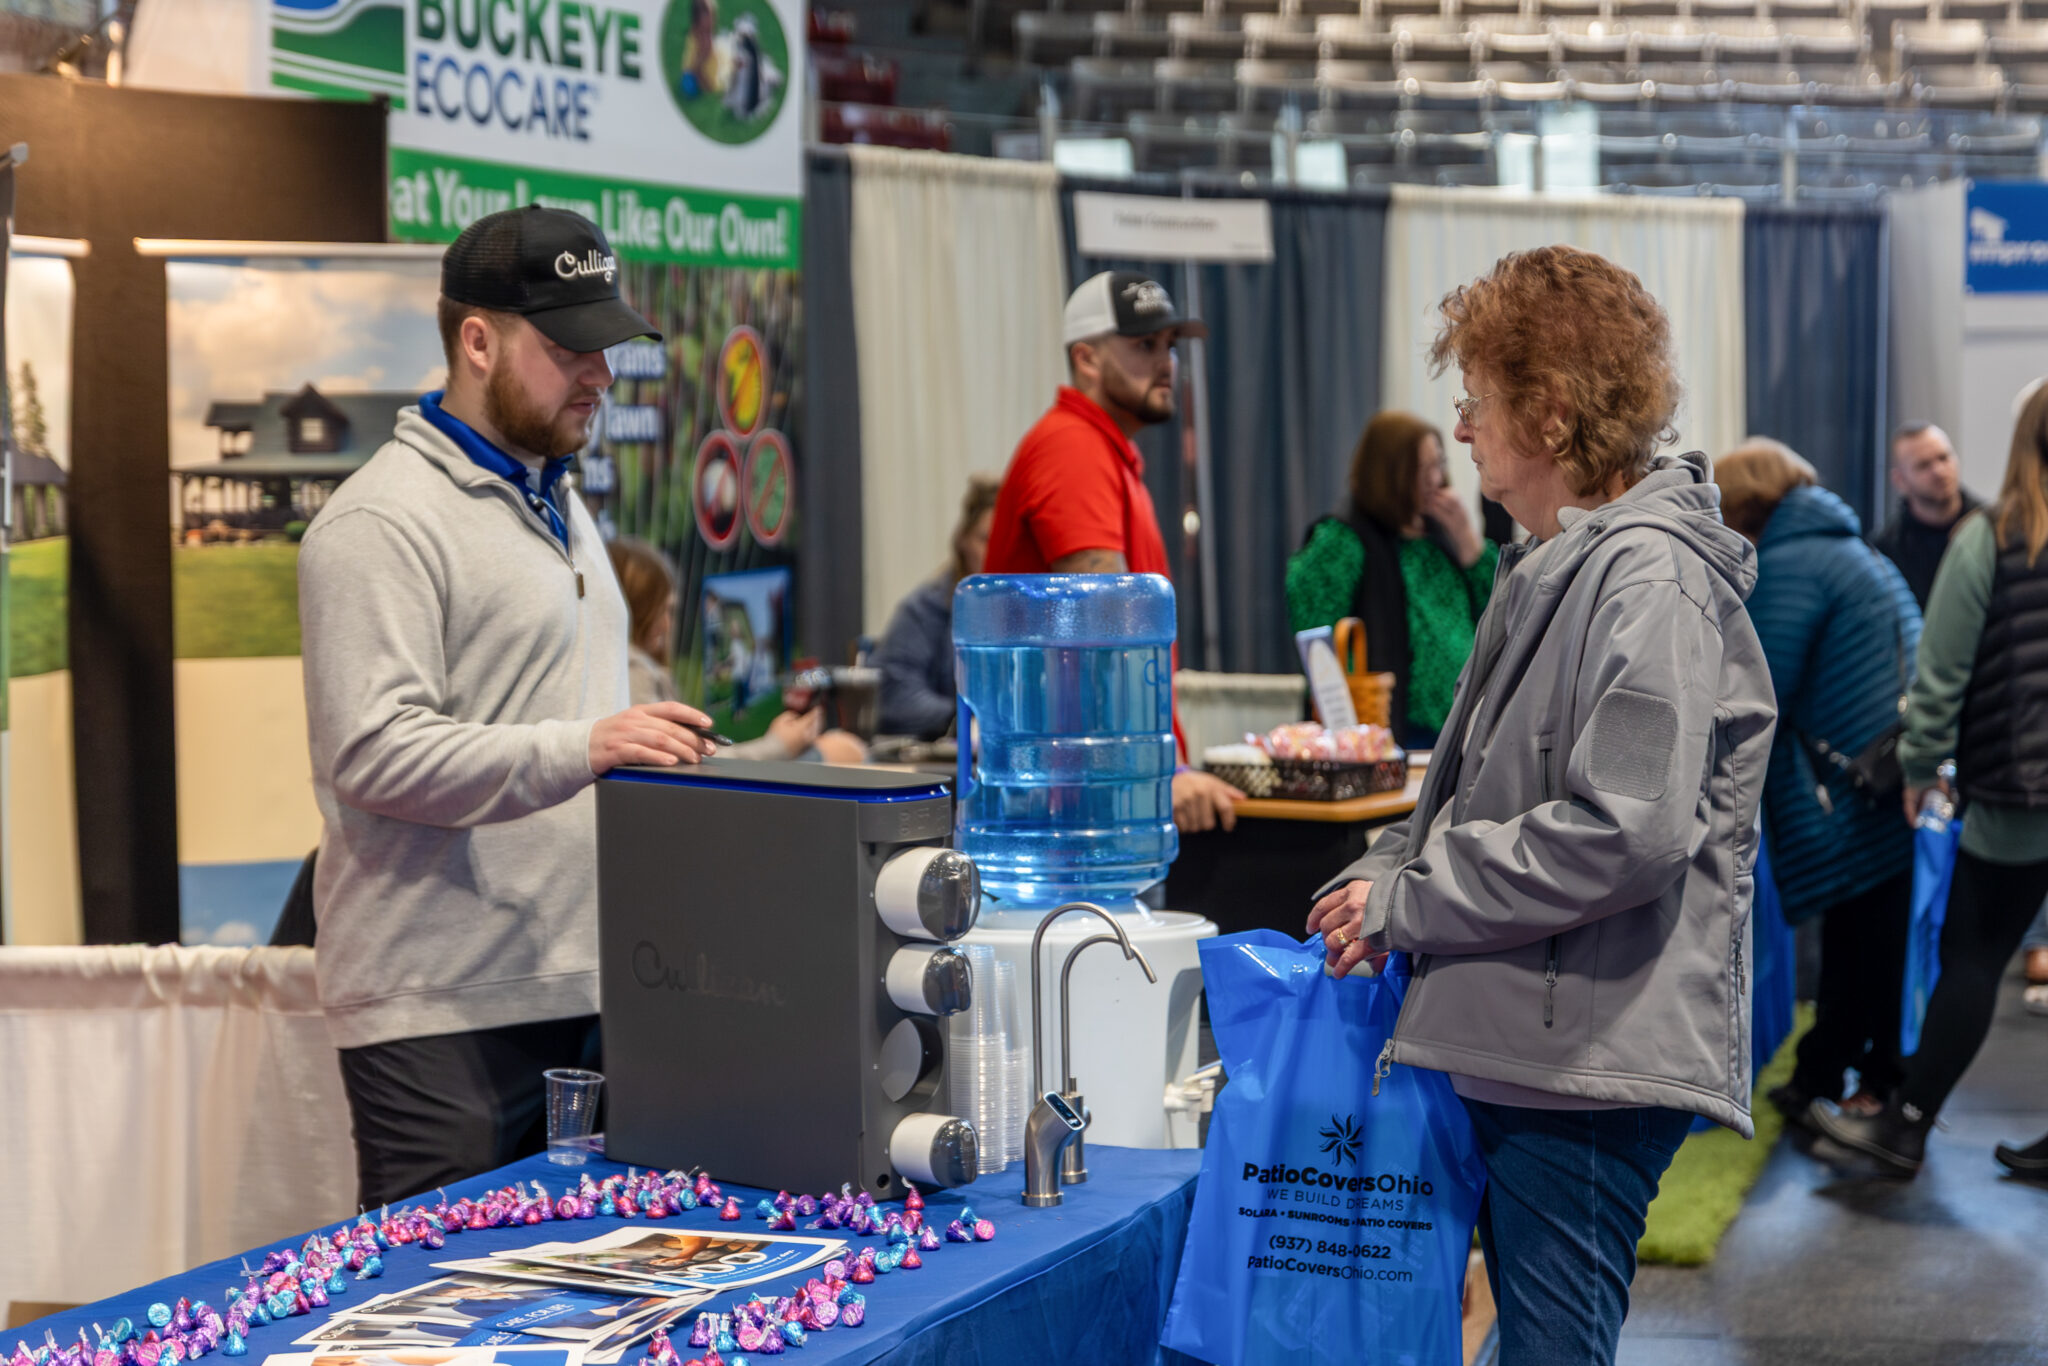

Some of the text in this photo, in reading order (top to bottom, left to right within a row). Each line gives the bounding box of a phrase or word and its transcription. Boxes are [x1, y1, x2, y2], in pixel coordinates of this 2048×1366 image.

[417, 0, 641, 79] BUCKEYE
[602, 189, 662, 248] Like
[664, 200, 718, 251] Our
[719, 204, 788, 258] Own!
[631, 939, 785, 1007] Cullian
[1242, 1162, 1434, 1197] PatioCoversOhio
[1266, 1188, 1404, 1212] WE BUILD DREAMS
[1238, 1206, 1278, 1219] SOLARA
[1287, 1210, 1350, 1227] SUNROOMS
[1387, 1219, 1433, 1232] COVERS
[1269, 1234, 1392, 1260] (937) 848-0622
[1247, 1255, 1413, 1283] PatioCoversOhio.com
